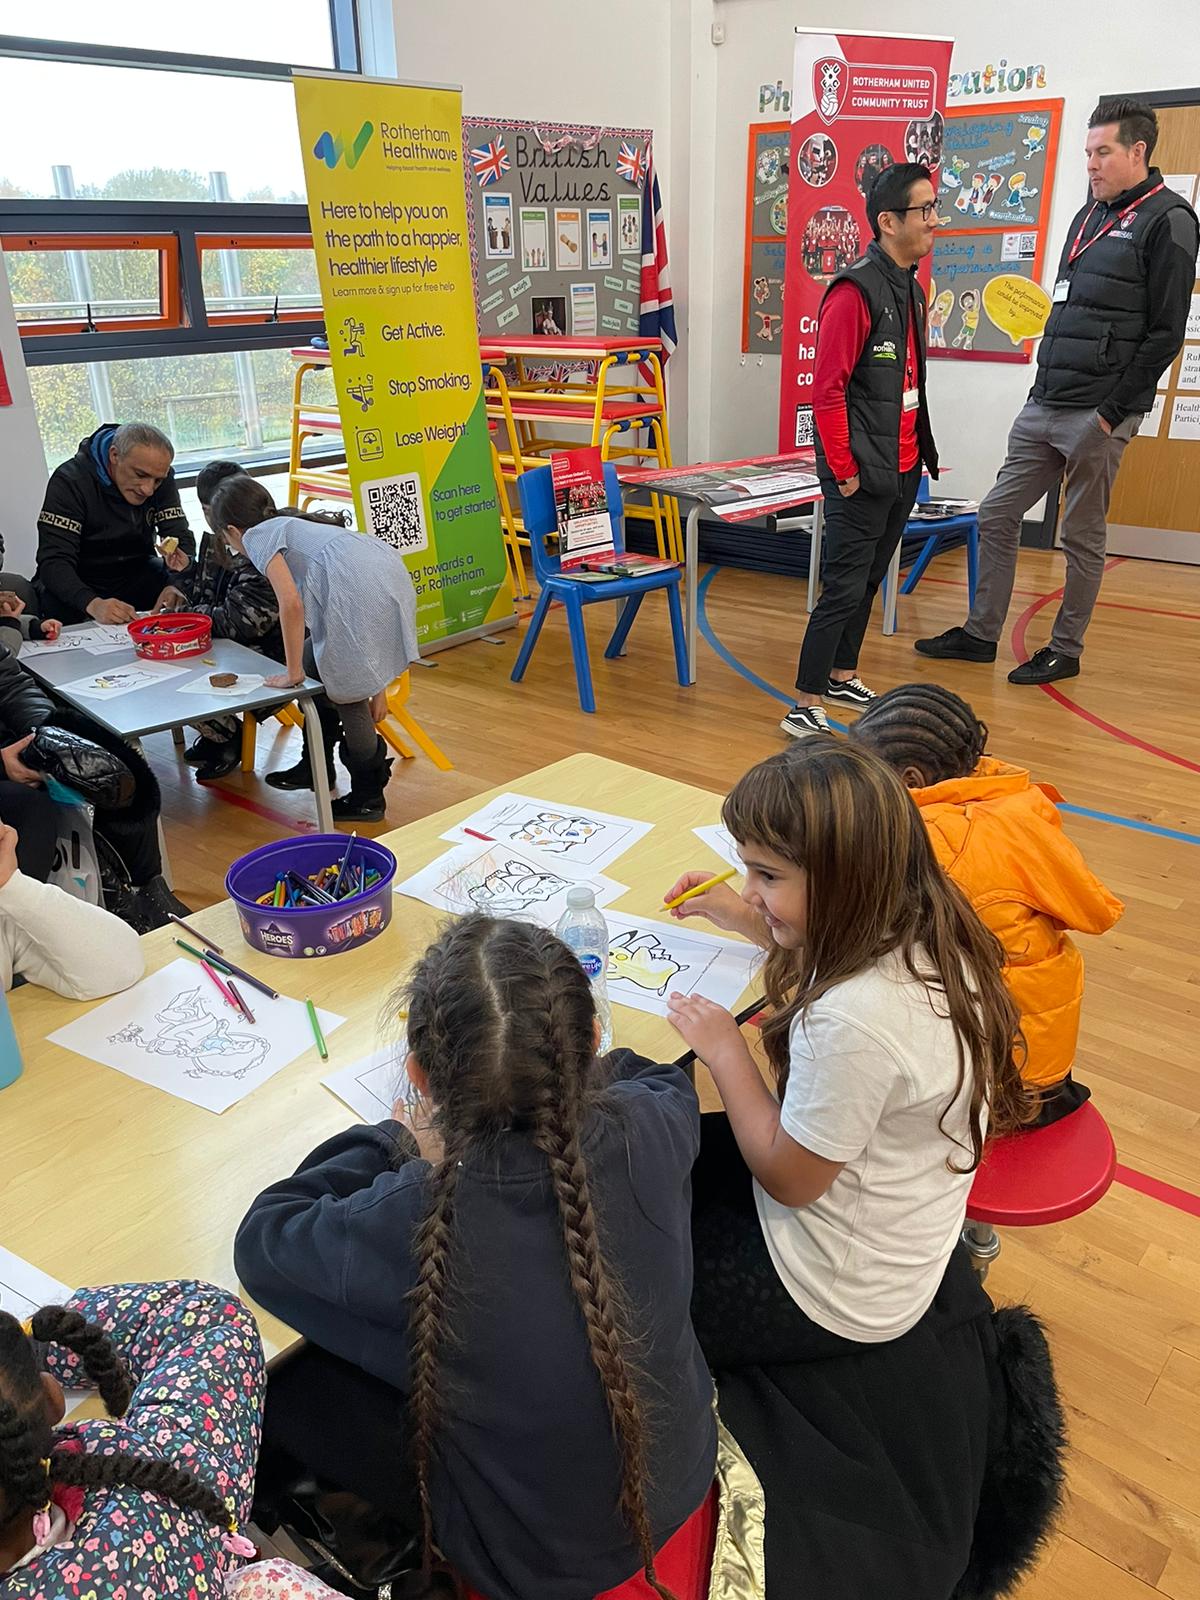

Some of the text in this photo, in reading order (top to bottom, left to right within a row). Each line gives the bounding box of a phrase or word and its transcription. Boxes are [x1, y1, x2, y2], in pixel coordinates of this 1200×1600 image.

[852, 76, 931, 89] ROTHERHAM UNITED
[759, 80, 792, 113] Ph
[851, 97, 929, 109] COMMUNITY TRUST
[380, 122, 451, 142] Rotherham
[383, 141, 458, 161] Healthwave
[516, 135, 611, 169] British
[519, 171, 611, 203] Values
[321, 201, 448, 224] Here to help you on
[325, 229, 463, 252] the path to a happier,
[329, 255, 437, 277] healthier lifestyle
[332, 281, 455, 298] Learn more & sign up for free help
[1013, 288, 1046, 309] performance
[381, 321, 446, 342] Get Active.
[388, 372, 473, 398] Stop Smoking.
[395, 421, 470, 448] Lose Weight.
[432, 482, 481, 503] Scan here
[435, 497, 496, 523] to get started
[423, 557, 465, 576] towards
[466, 555, 474, 564] a
[429, 567, 485, 591] Rotherham
[260, 931, 293, 945] HEROES
